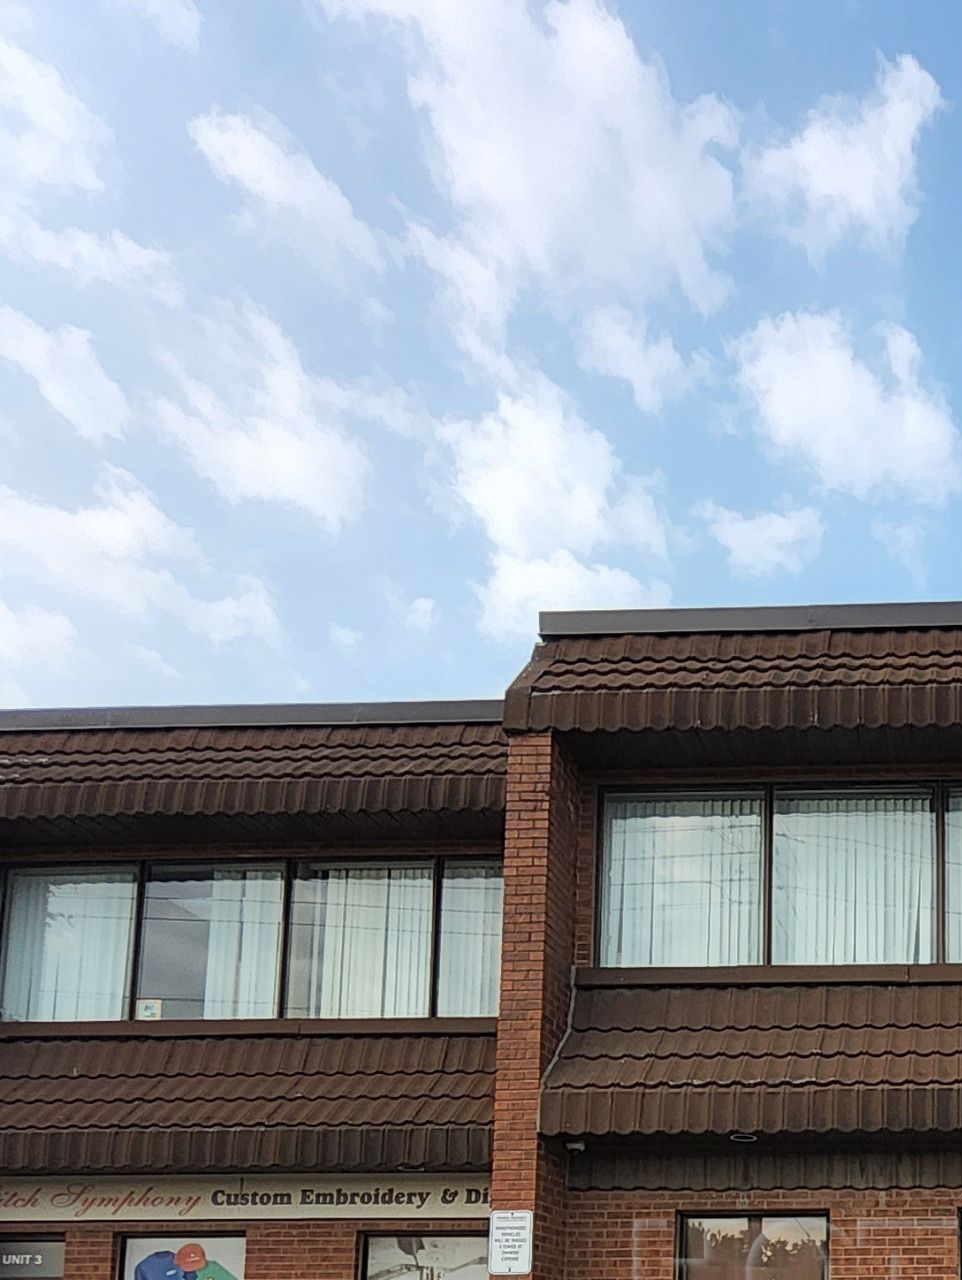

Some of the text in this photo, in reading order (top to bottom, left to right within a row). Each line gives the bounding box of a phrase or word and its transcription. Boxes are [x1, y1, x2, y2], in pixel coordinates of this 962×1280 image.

[51, 1182, 201, 1216] Symphony
[211, 1189, 292, 1206] Custom
[300, 1187, 431, 1209] Embroidery
[441, 1188, 459, 1204] &
[2, 1254, 42, 1265] UNIT 3
